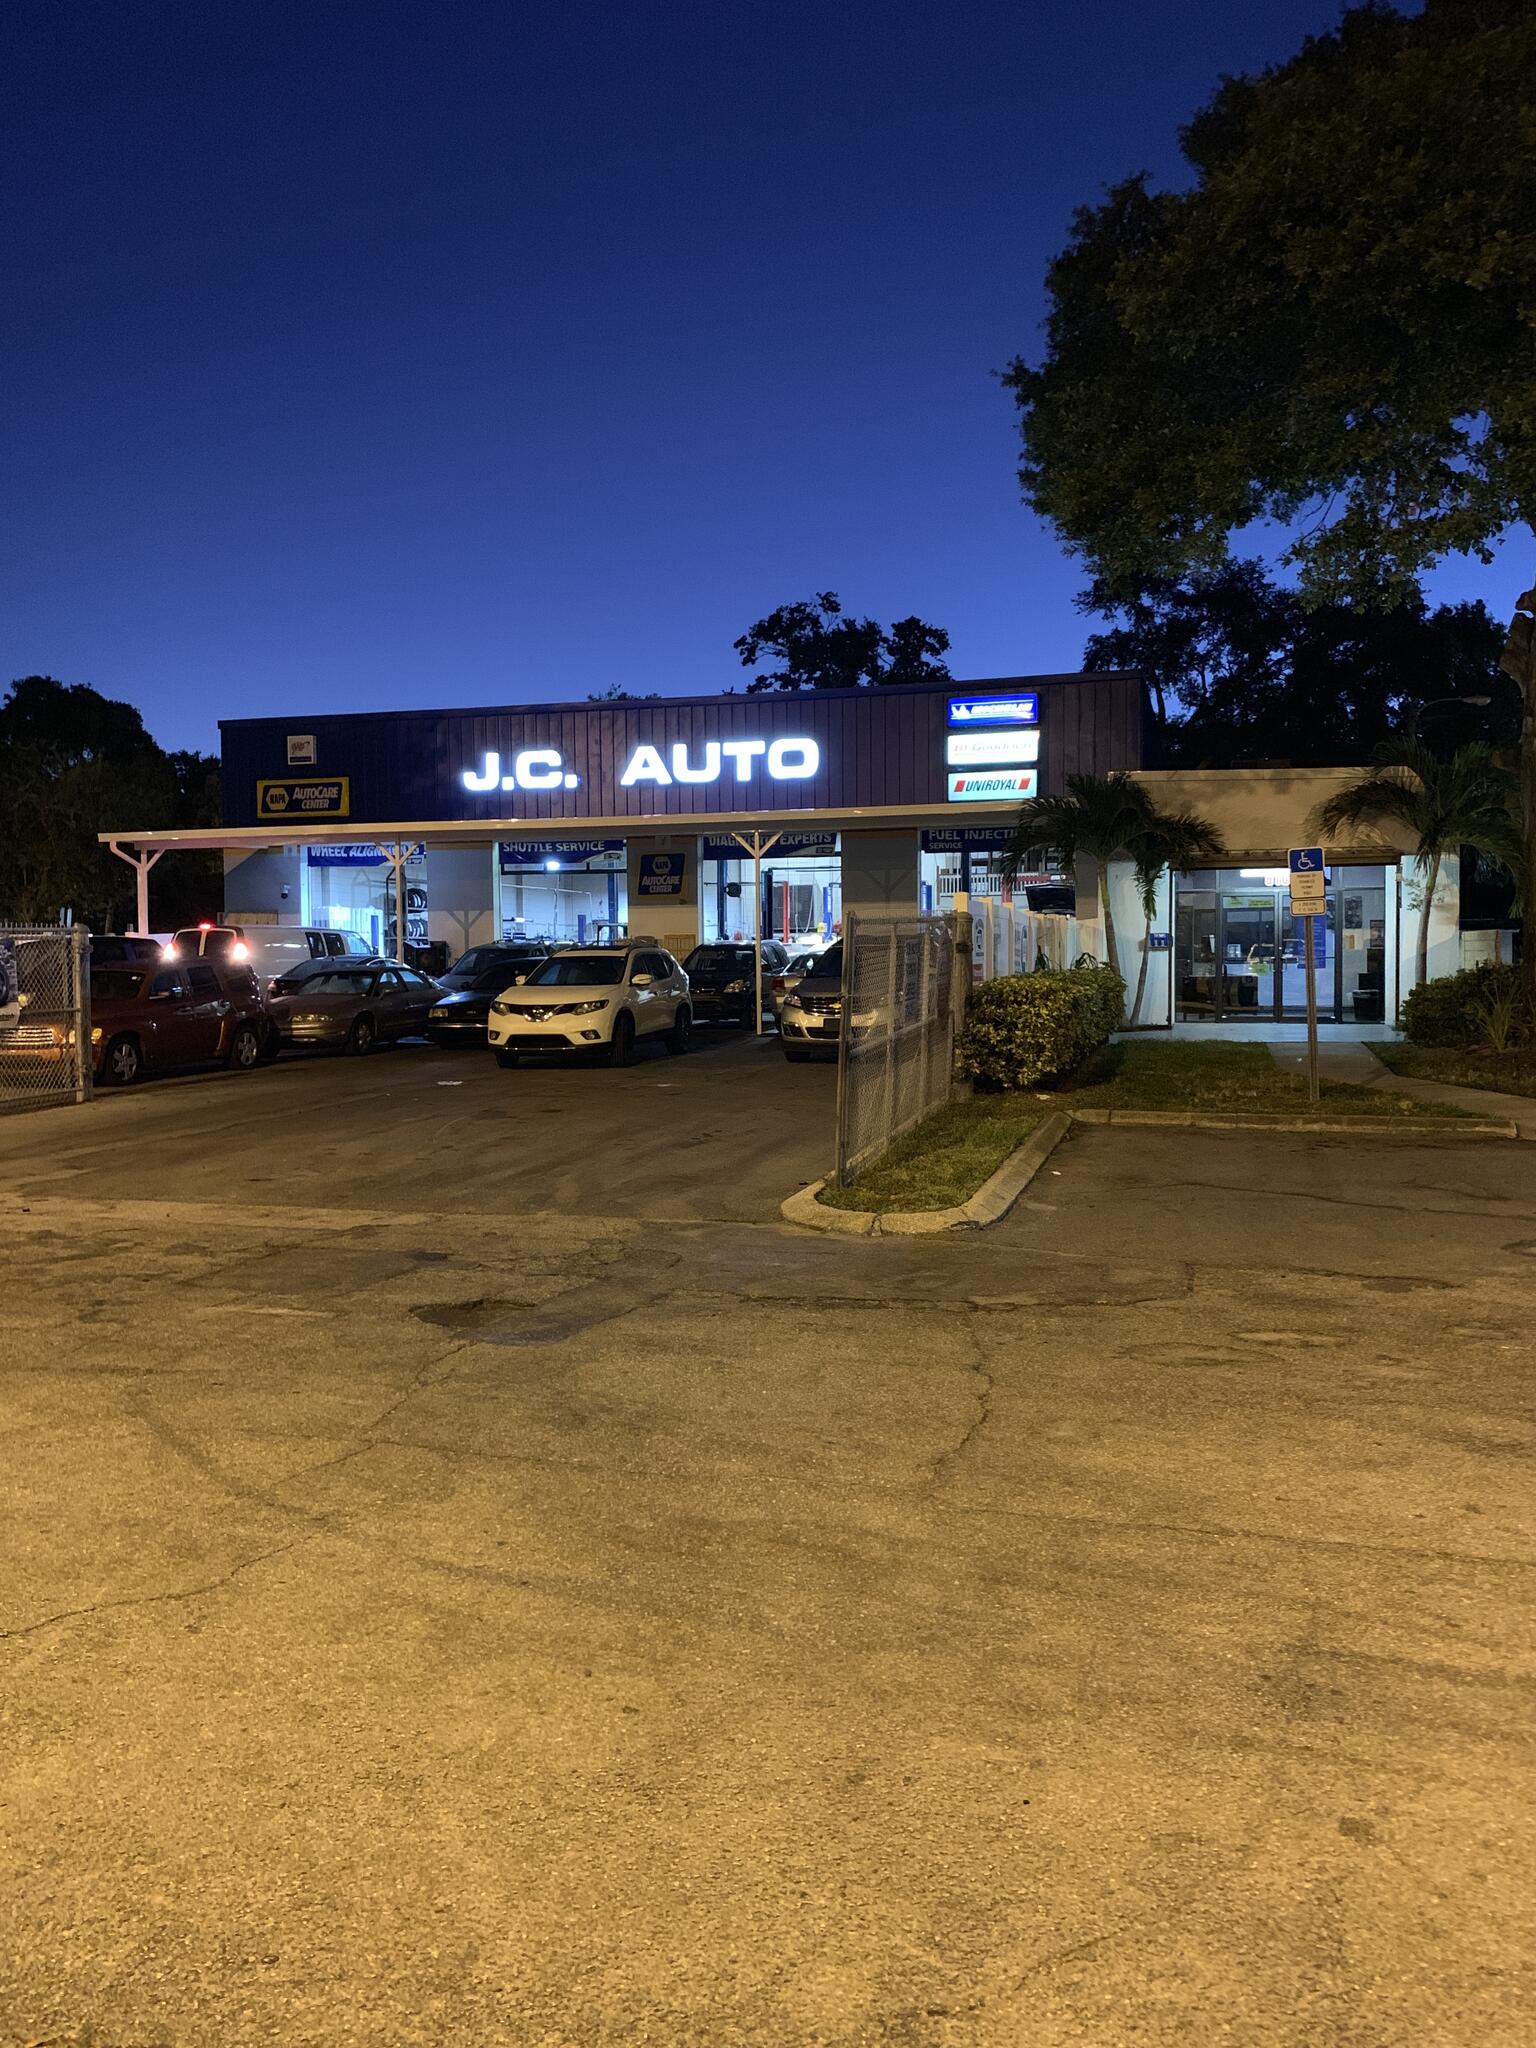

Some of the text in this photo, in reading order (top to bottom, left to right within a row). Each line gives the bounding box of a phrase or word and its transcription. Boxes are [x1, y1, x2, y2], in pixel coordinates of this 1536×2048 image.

[463, 737, 820, 791] J.C. AUTO
[966, 779, 1017, 792] UNIROYAL
[301, 799, 330, 809] CENTER
[780, 831, 832, 845] EXPERTS
[928, 830, 961, 840] FUEL
[311, 845, 348, 857] WHEEL
[503, 840, 605, 853] SHUTTLE SERVICE
[928, 841, 963, 850] SERVICE
